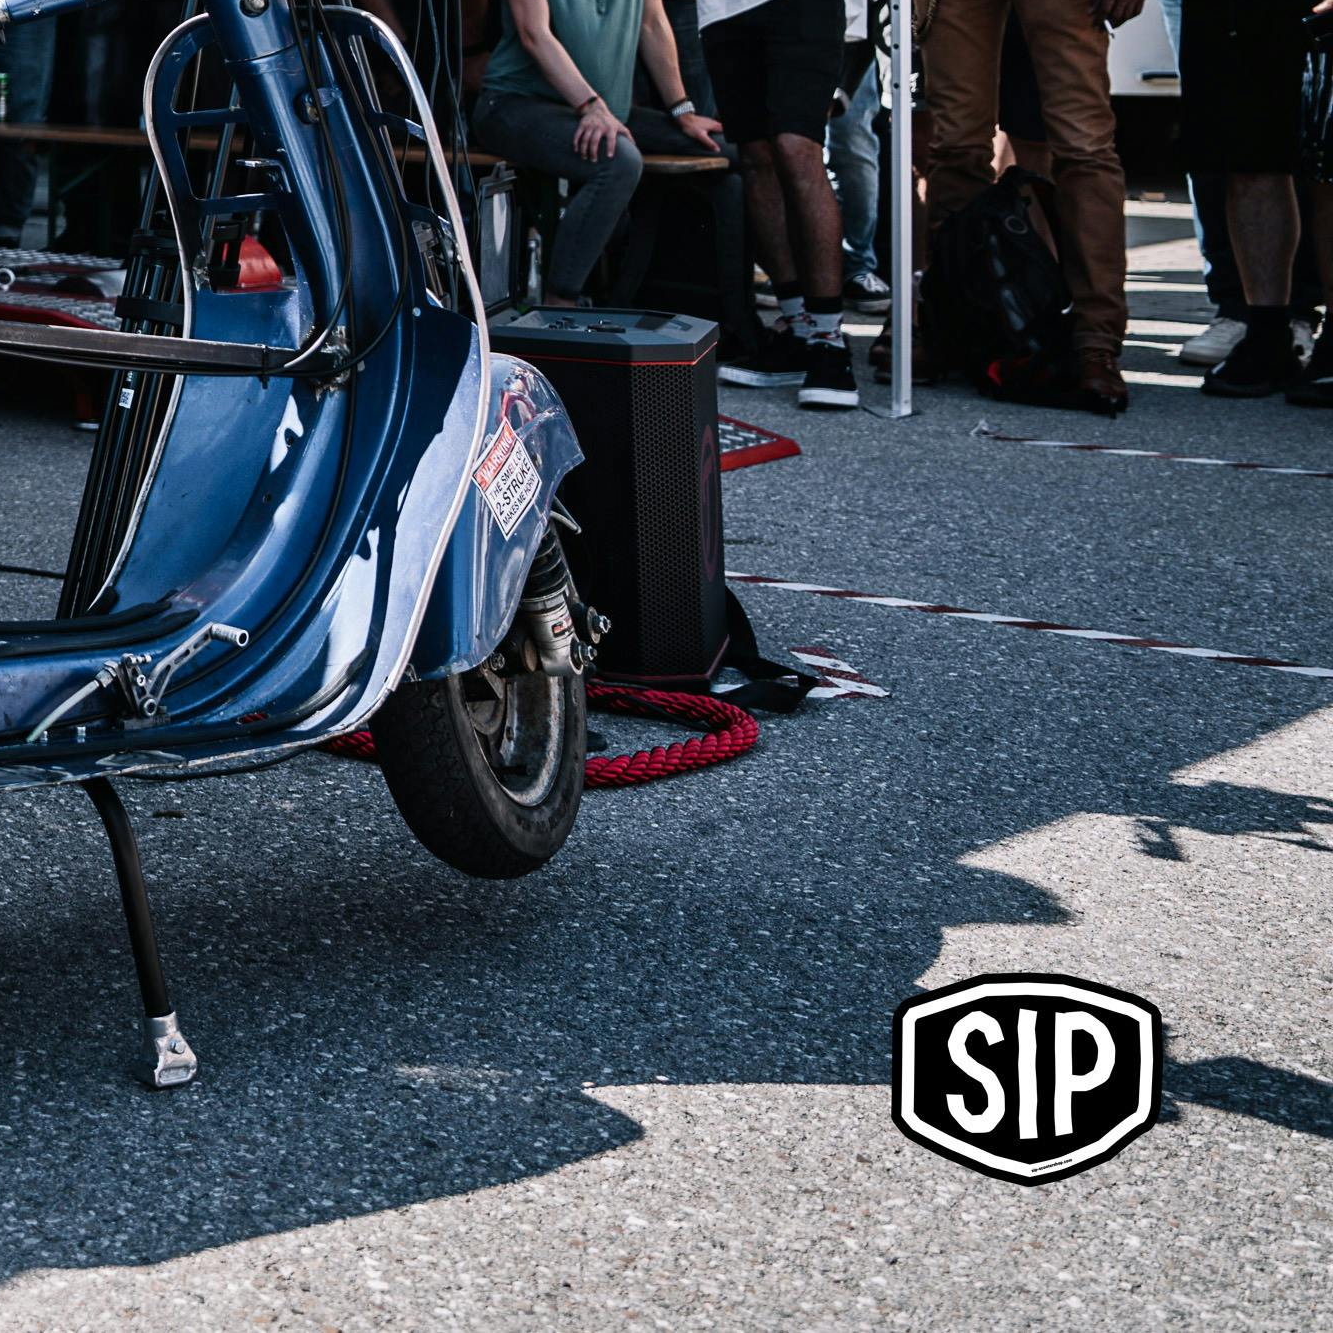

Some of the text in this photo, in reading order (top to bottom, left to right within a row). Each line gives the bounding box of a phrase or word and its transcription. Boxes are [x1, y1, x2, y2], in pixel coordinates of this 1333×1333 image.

[480, 432, 513, 481] WARNING
[489, 484, 503, 501] THE
[501, 456, 518, 484] SMELL
[496, 458, 532, 516] 2-STROKE
[502, 501, 520, 526] MAKES
